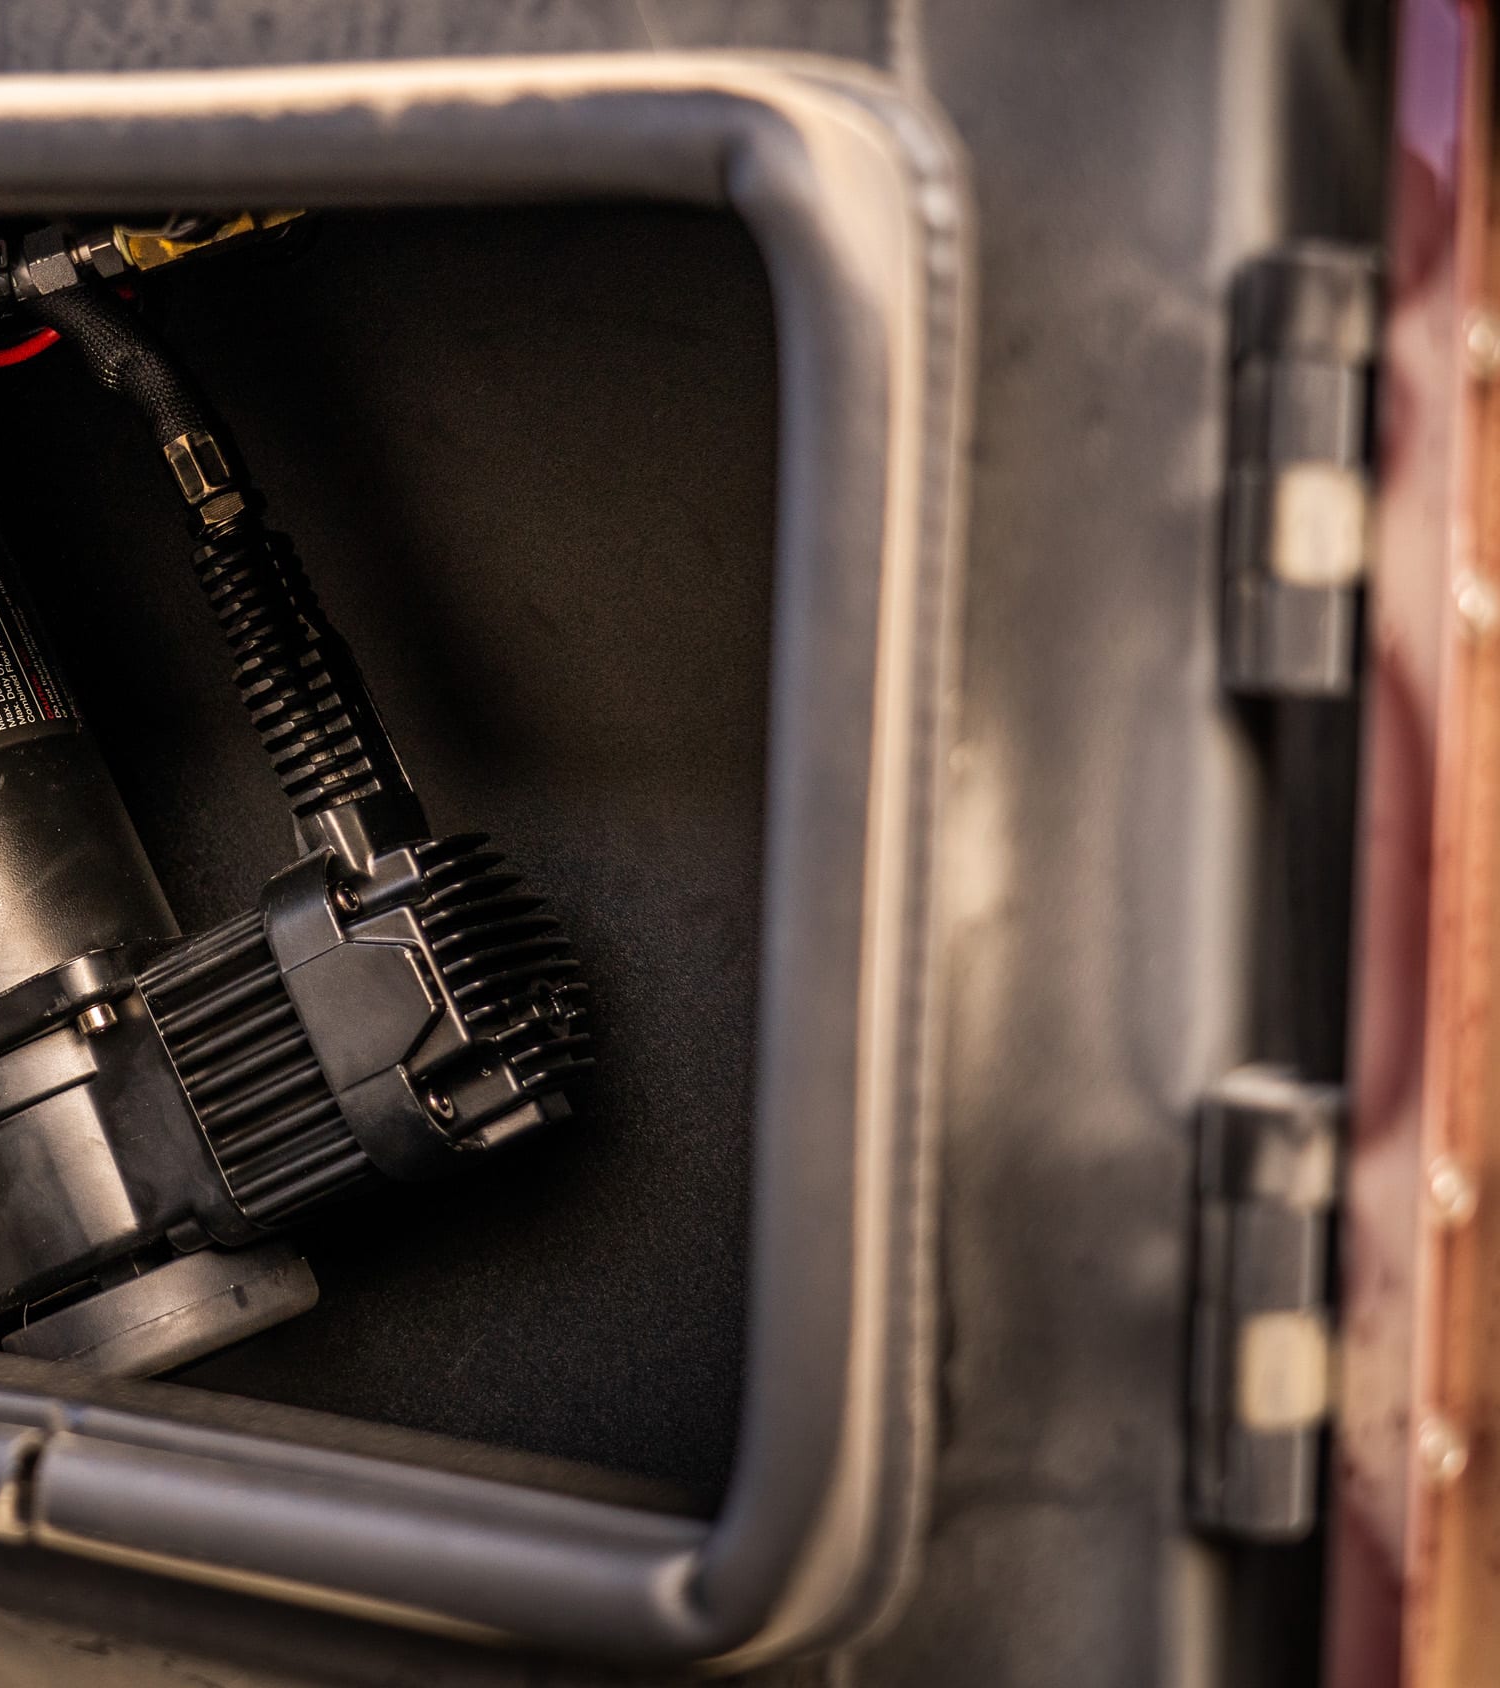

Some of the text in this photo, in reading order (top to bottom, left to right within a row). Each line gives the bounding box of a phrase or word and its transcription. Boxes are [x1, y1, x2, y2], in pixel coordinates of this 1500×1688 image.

[0, 650, 15, 673] Flow
[1, 677, 16, 700] Duty
[11, 674, 36, 723] Combined
[3, 703, 18, 728] Max.
[13, 701, 28, 726] Max.
